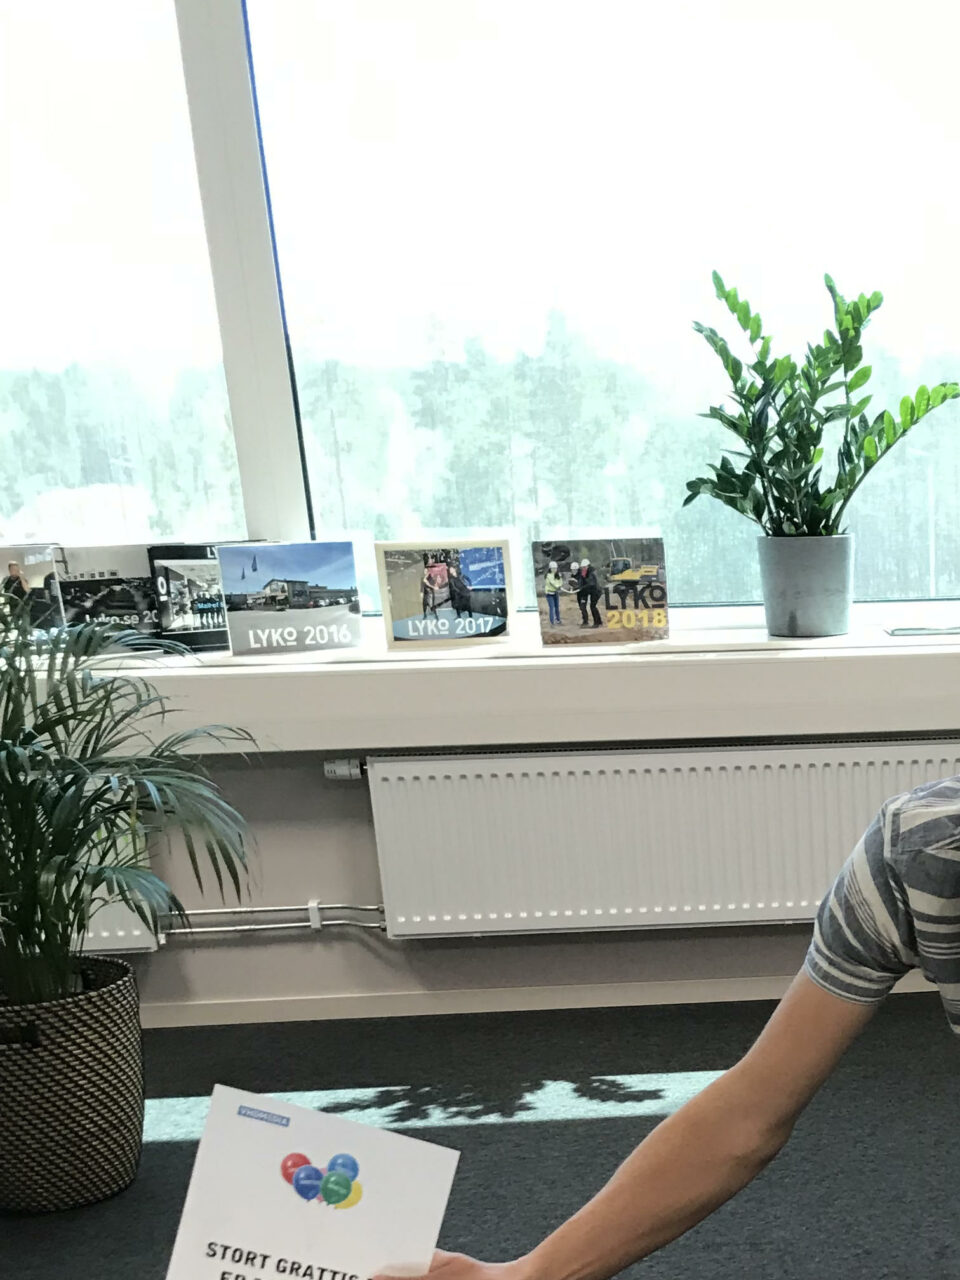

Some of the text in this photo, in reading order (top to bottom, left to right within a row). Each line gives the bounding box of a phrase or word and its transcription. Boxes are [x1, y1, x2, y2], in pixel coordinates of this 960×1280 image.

[455, 617, 494, 634] 2017
[607, 609, 667, 629] 2018
[303, 624, 353, 645] 2016
[206, 1241, 271, 1269] STORT
